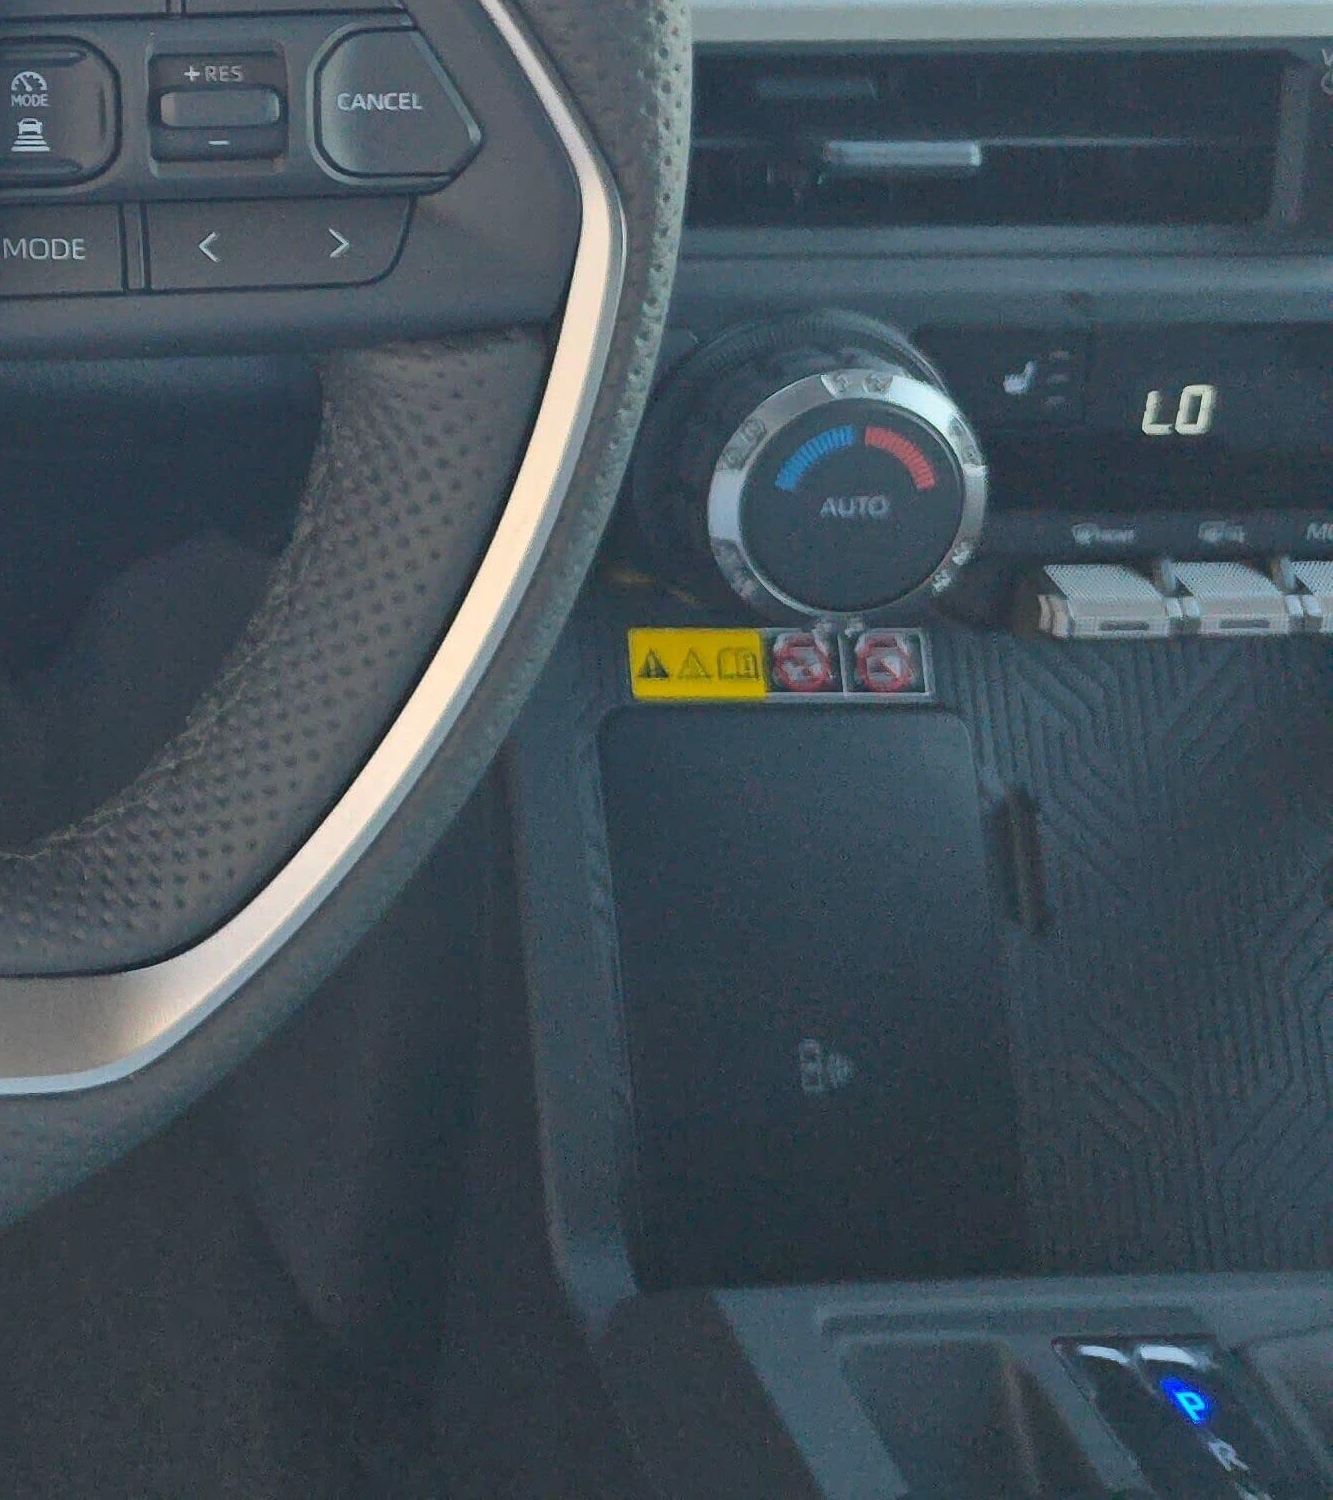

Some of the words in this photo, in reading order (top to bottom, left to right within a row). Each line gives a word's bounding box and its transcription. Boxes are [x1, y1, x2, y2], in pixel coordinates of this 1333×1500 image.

[10, 94, 49, 107] MODE
[336, 91, 423, 112] CANCEL
[2, 237, 86, 261] MODE
[819, 495, 890, 518] AUTO
[1173, 1391, 1205, 1422] P
